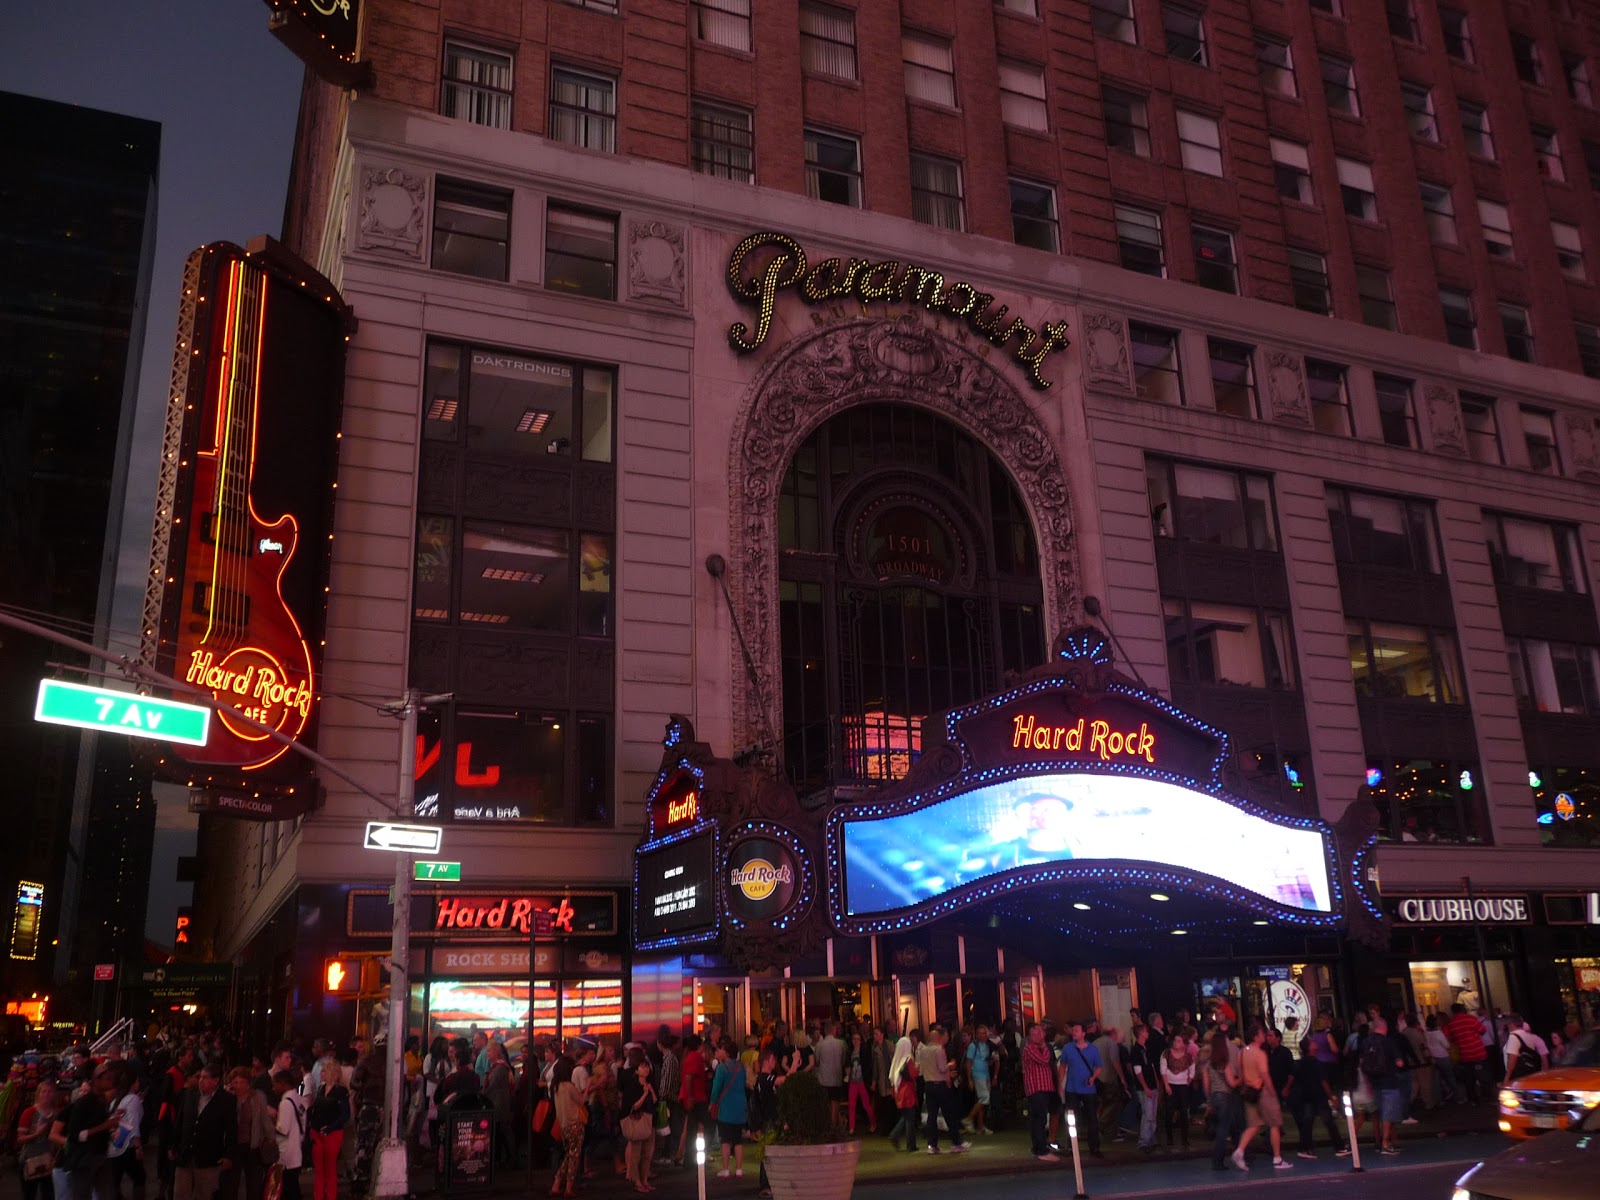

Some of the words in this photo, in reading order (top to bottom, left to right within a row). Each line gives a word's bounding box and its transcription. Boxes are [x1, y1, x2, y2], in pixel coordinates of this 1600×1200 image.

[726, 232, 1070, 391] Paramount
[472, 354, 572, 378] DAKTRONICS
[888, 533, 931, 555] 1501
[877, 560, 944, 579] BROADWAY
[185, 649, 254, 694] Hard
[254, 667, 311, 717] Rock
[95, 698, 114, 721] 7
[1013, 714, 1084, 751] Hard
[1090, 719, 1155, 763] Rock
[668, 795, 689, 824] Hard
[426, 864, 435, 878] 7
[438, 864, 449, 872] AV
[731, 867, 758, 886] Hard
[758, 864, 790, 884] Rock
[435, 897, 509, 930] Hard
[1402, 898, 1528, 922] CLUBHOUSE
[446, 953, 496, 967] ROCK
